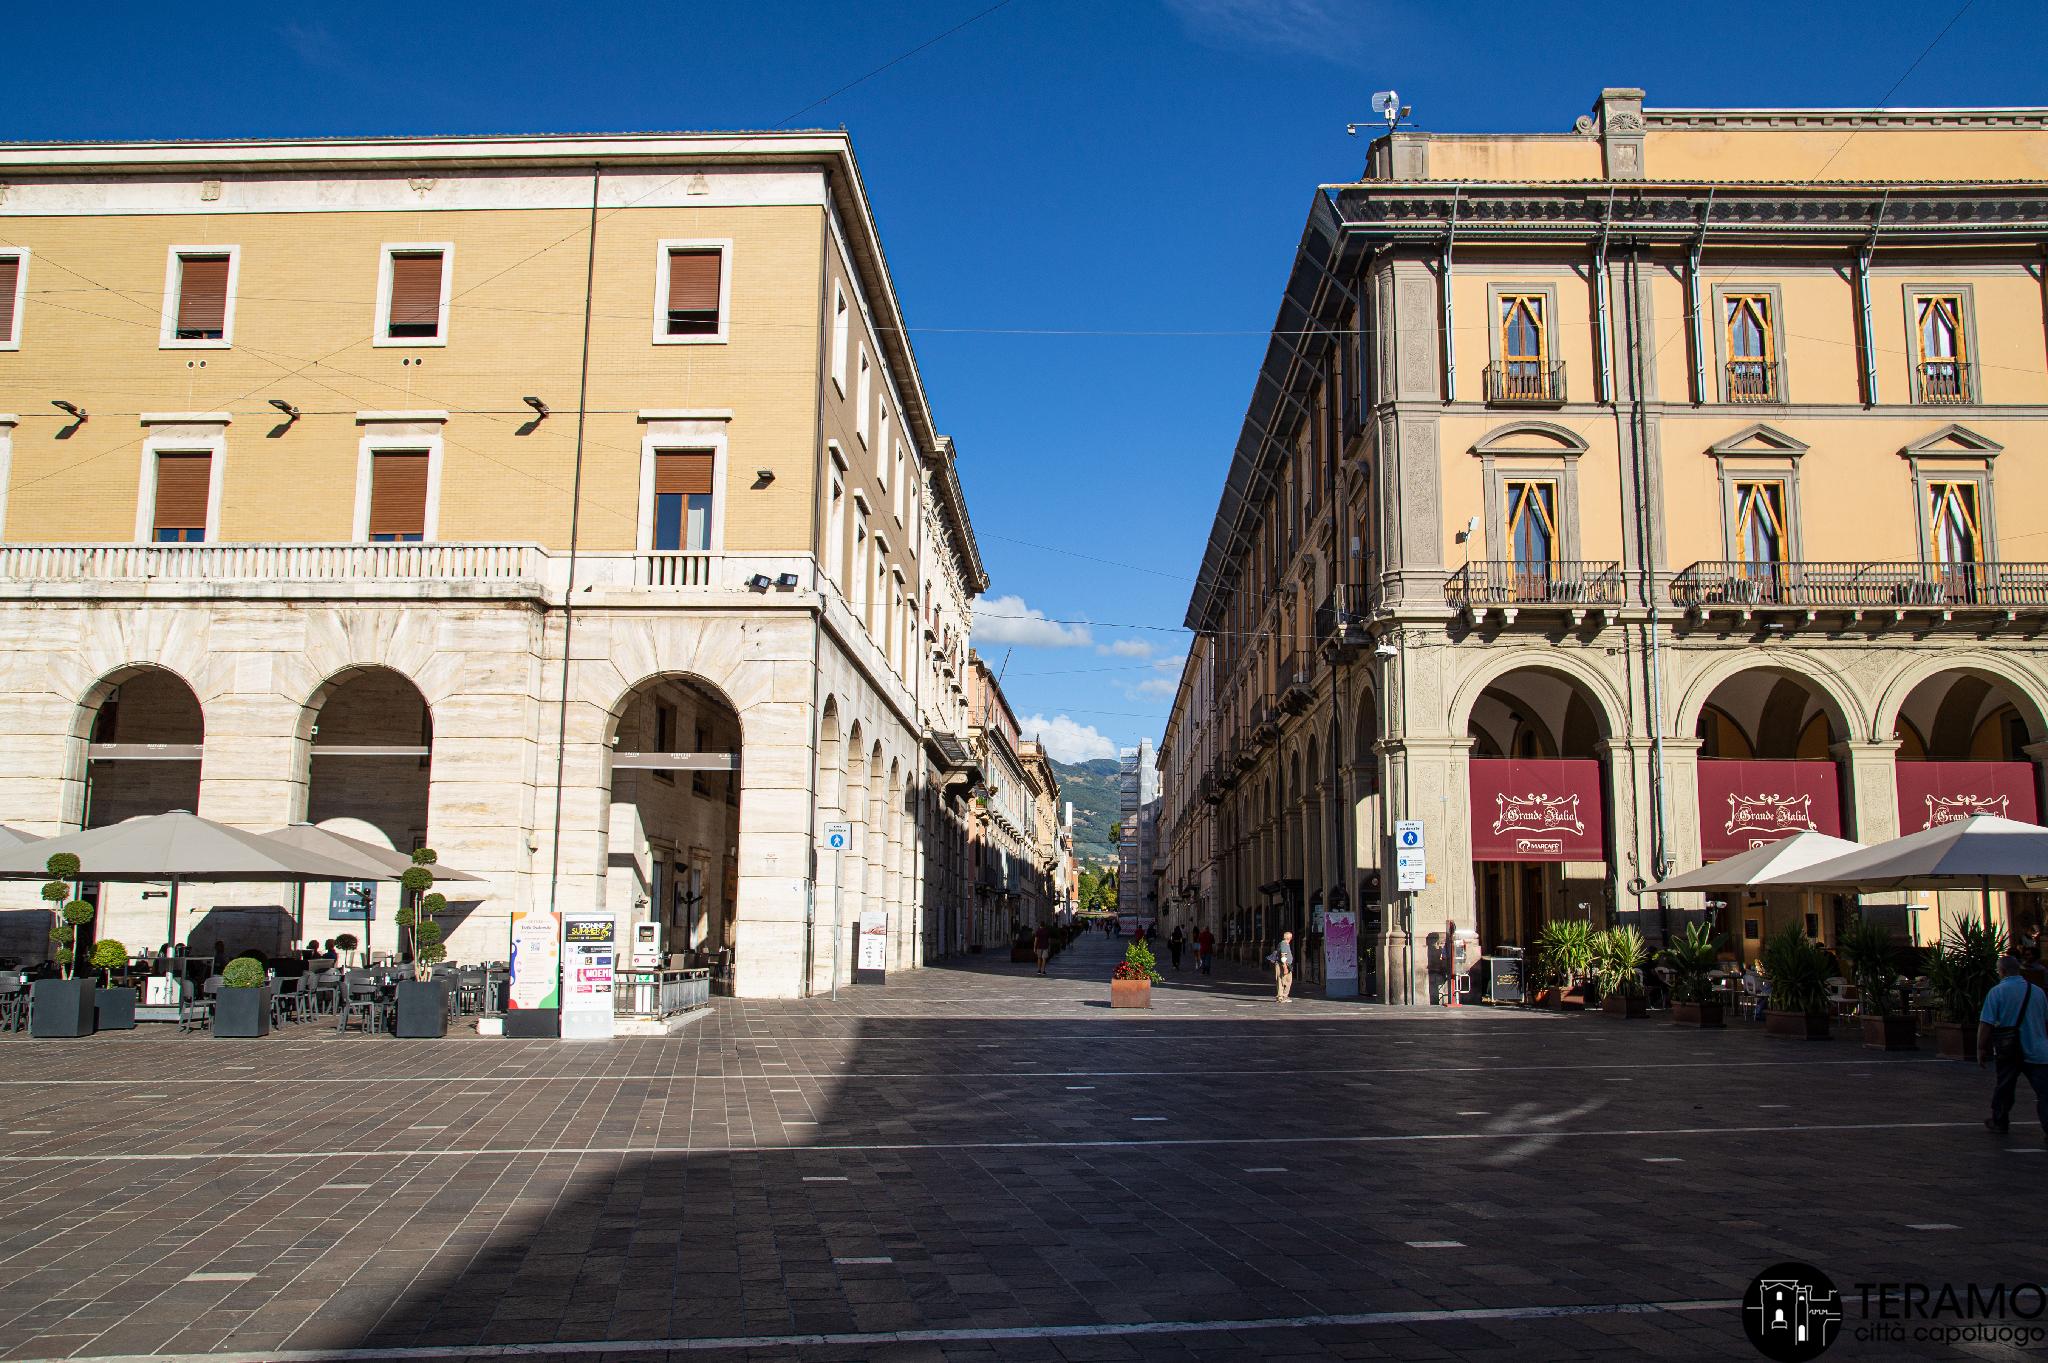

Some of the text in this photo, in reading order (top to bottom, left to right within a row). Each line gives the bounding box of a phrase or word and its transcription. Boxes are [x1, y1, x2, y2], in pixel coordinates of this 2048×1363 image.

[1504, 807, 1575, 824] Grande Italia
[1735, 807, 1806, 823] Grande Italia
[1933, 807, 1970, 823] Grand
